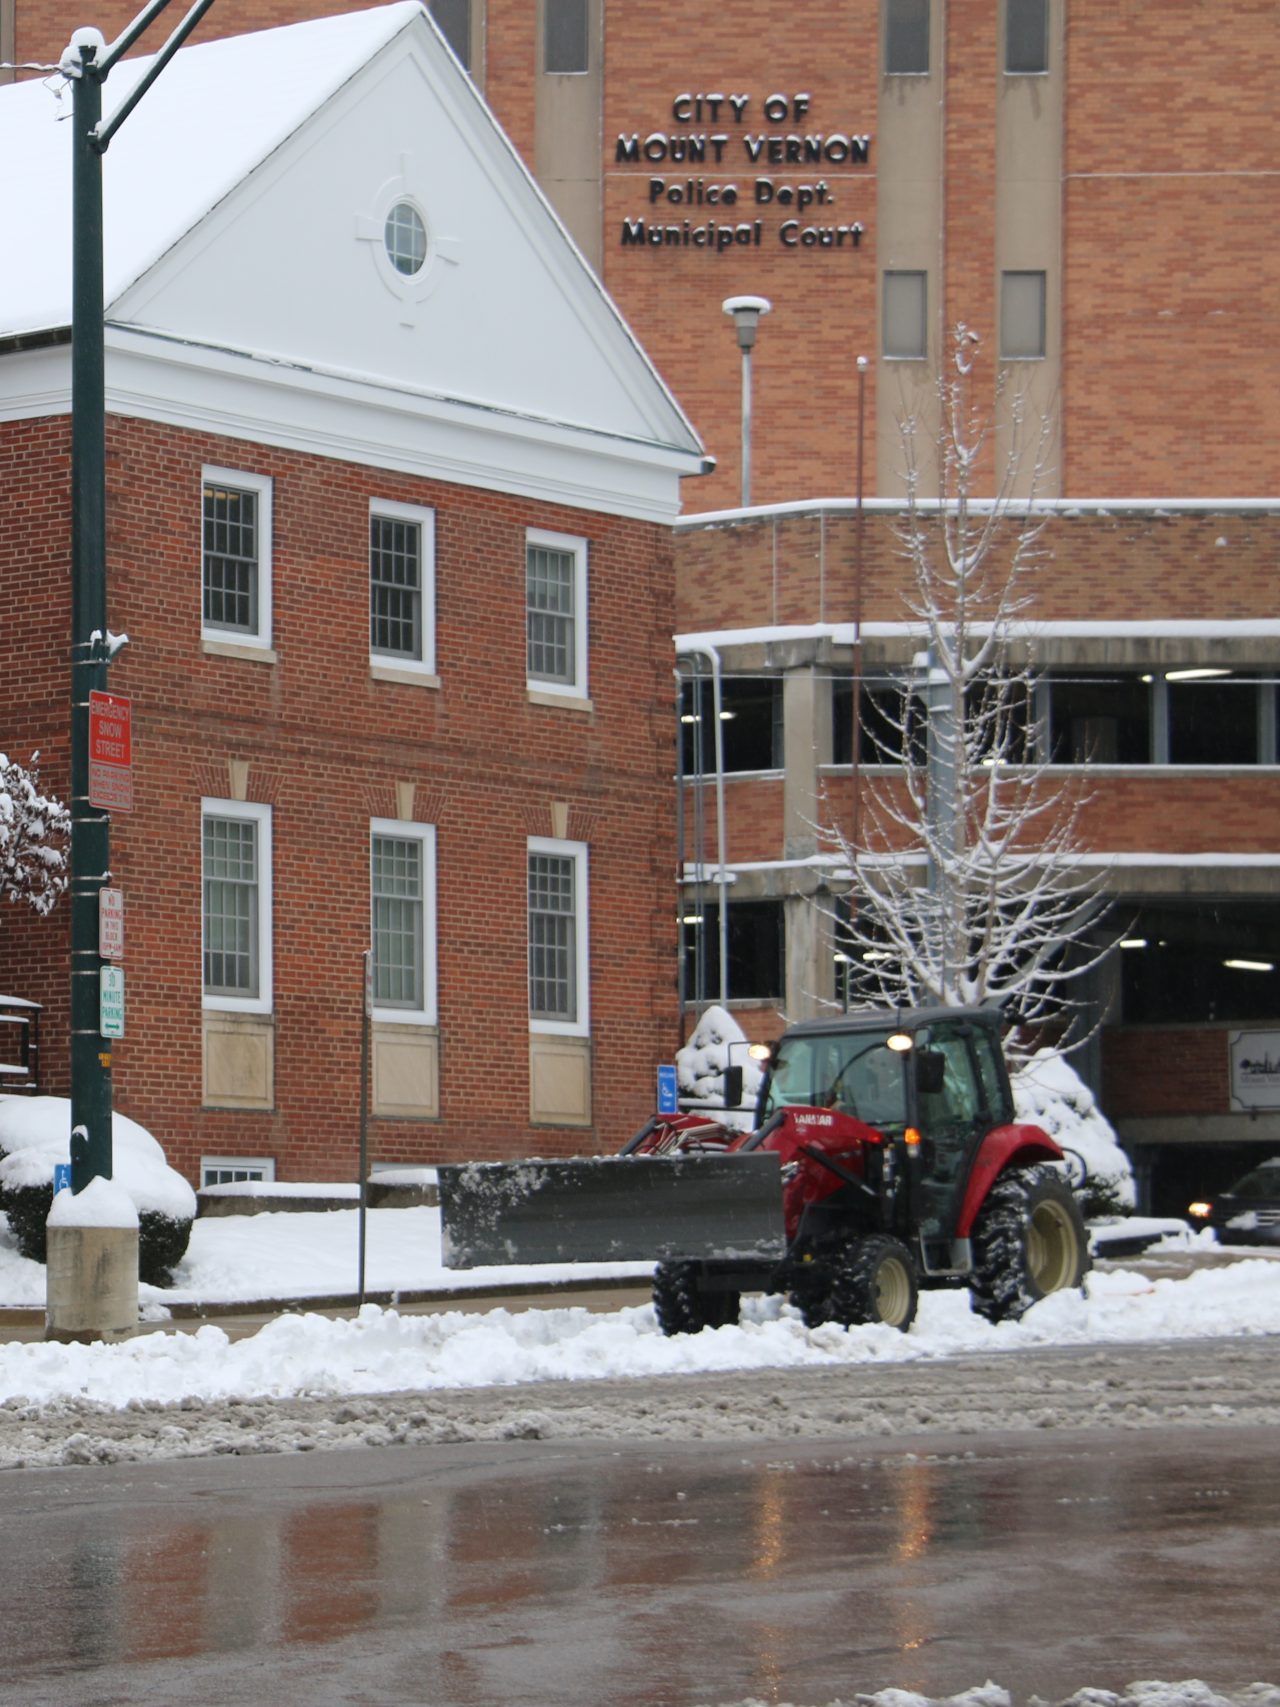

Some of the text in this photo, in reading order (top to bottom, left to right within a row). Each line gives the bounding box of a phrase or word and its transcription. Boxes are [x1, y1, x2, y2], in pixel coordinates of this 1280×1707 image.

[673, 93, 811, 123] CITY OF
[616, 132, 871, 164] MOUNT VERNON
[649, 177, 835, 211] Police Dept.
[621, 217, 865, 251] Municipal Court
[91, 700, 129, 721] EMERGENCY
[99, 720, 122, 738] SNOW
[96, 740, 125, 759] STREET
[101, 907, 122, 920] PARKING
[103, 991, 121, 1003] MINUTE
[102, 1006, 122, 1020] PARKING
